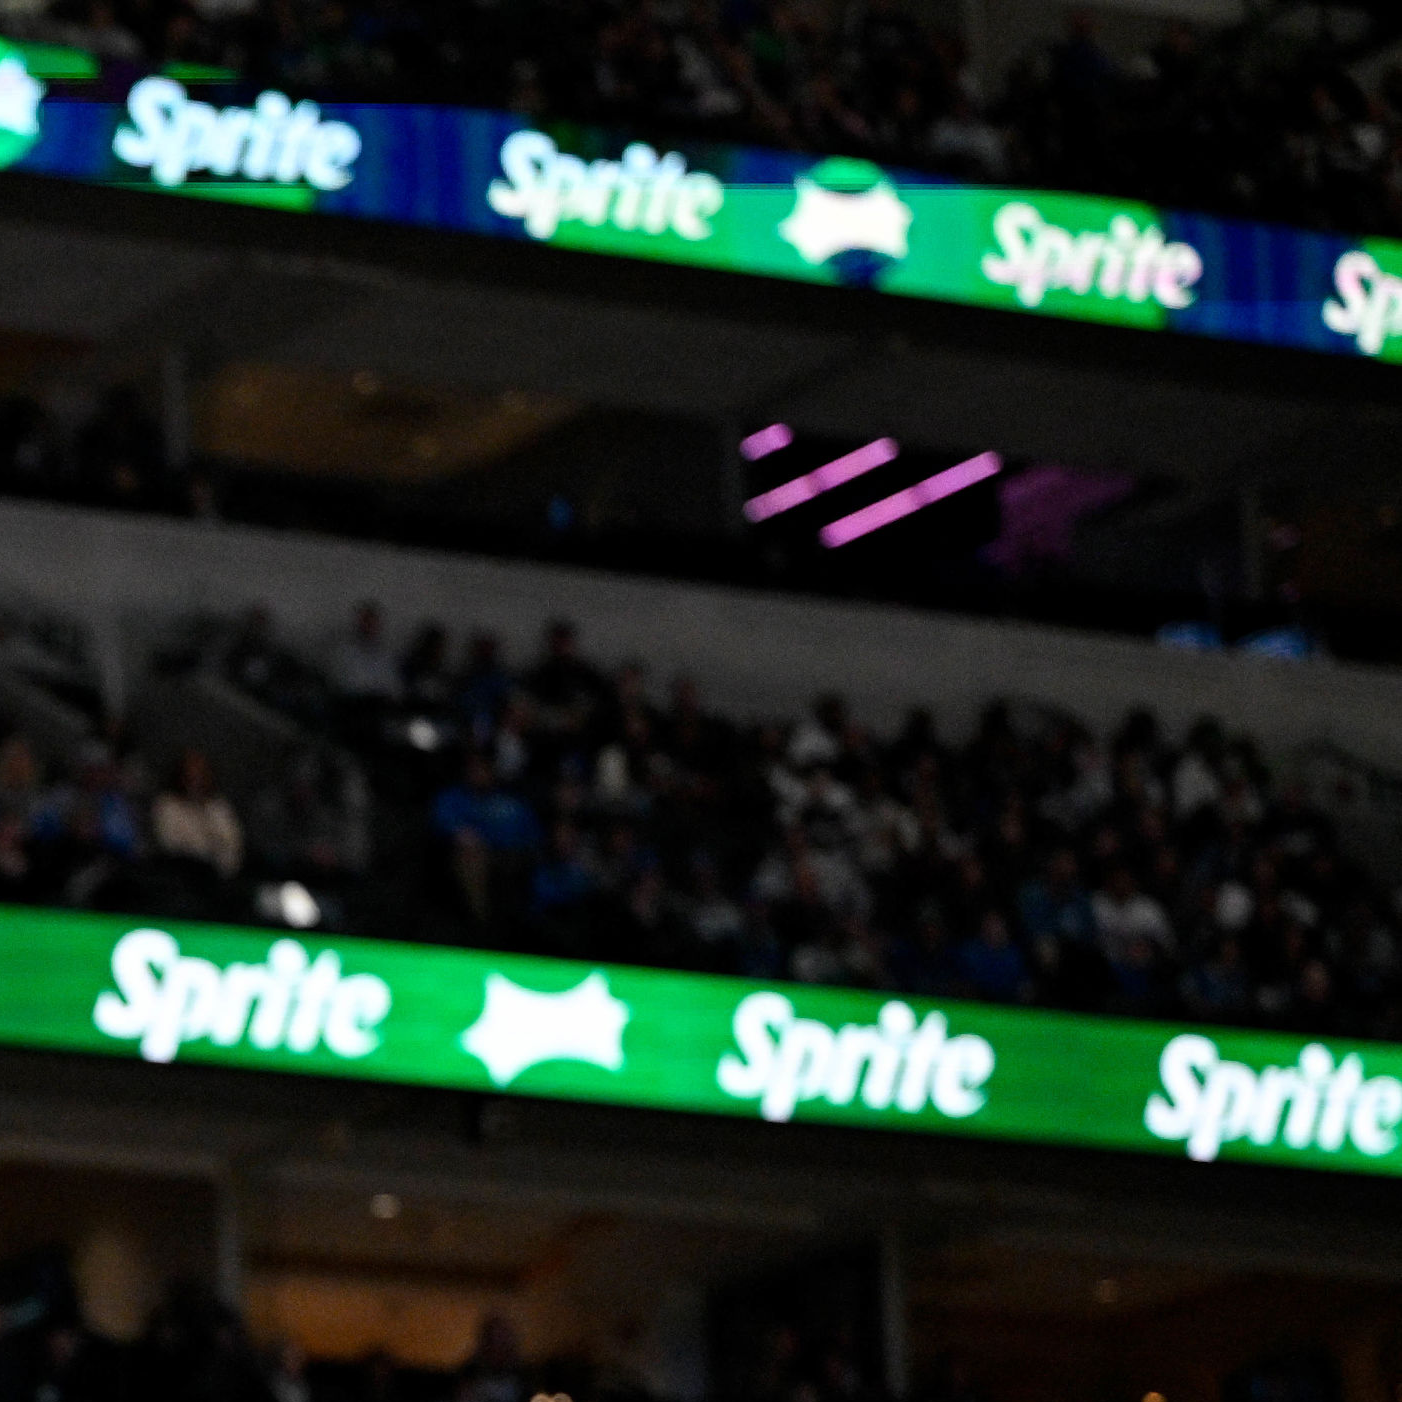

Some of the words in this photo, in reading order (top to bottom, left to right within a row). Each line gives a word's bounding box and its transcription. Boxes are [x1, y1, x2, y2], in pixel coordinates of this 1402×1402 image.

[113, 76, 360, 190] Sprite
[487, 131, 724, 240] Sprite
[981, 202, 1202, 308] Sprite
[93, 925, 392, 1064] Sprite
[716, 991, 995, 1123] Sprite
[1144, 1033, 1402, 1162] Sprite
